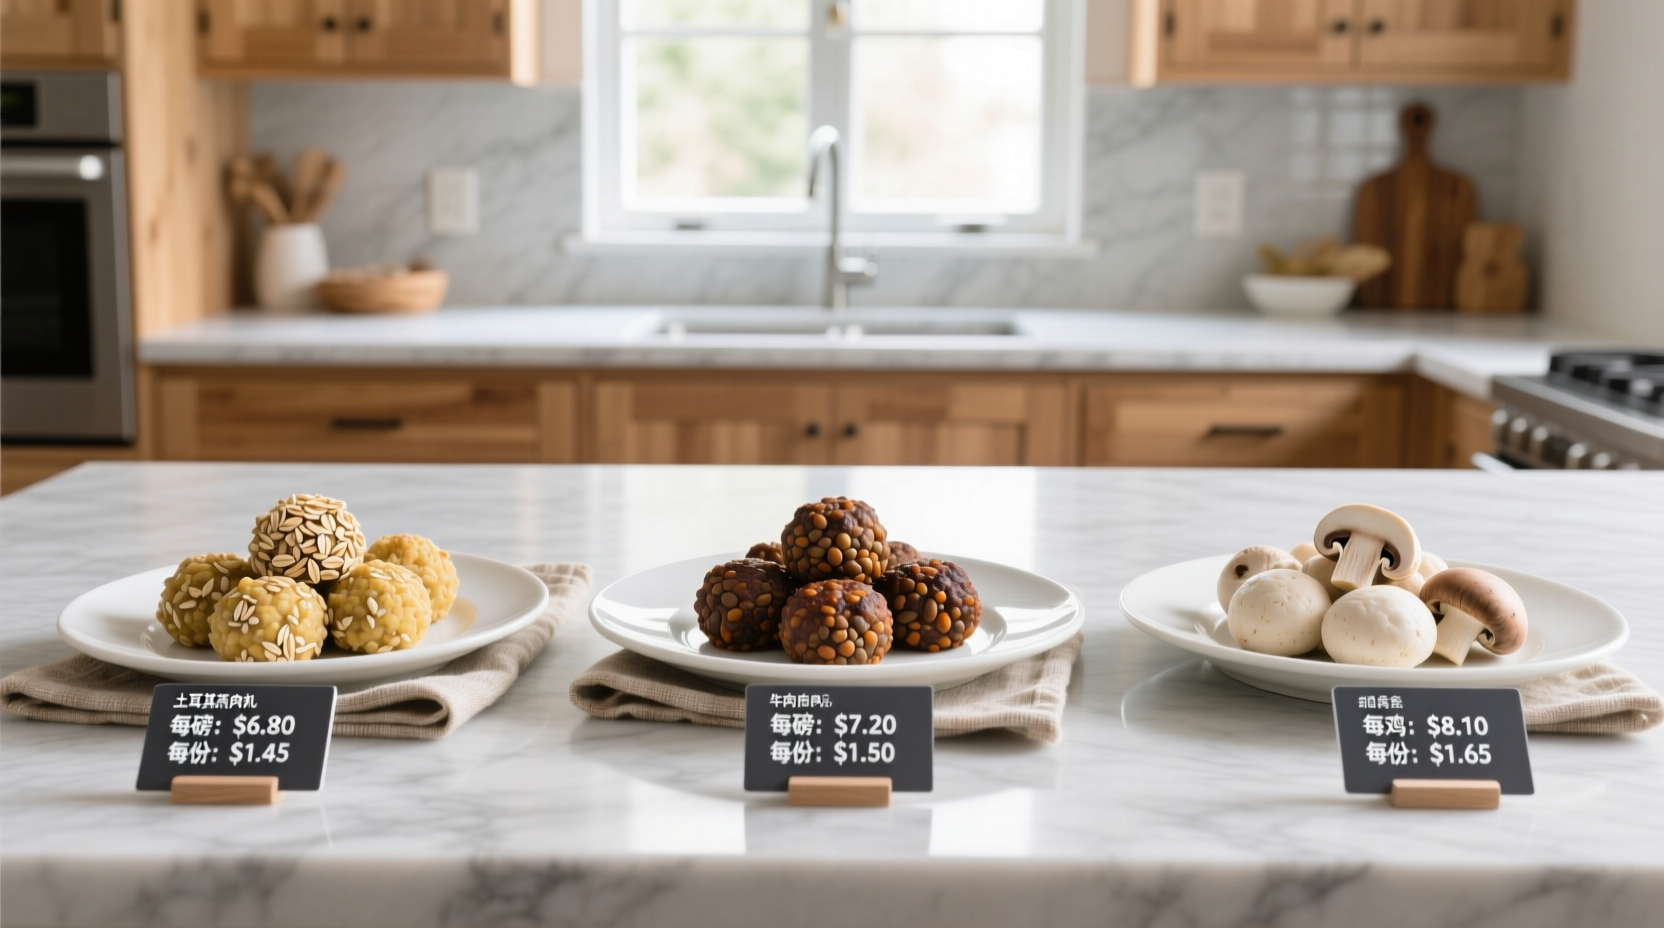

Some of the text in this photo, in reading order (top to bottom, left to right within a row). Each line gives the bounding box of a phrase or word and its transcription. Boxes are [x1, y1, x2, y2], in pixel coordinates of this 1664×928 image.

[232, 714, 296, 739] $6.80
[834, 712, 897, 738] $7.20
[1427, 714, 1489, 739] $8.10
[229, 741, 290, 766] $1.45
[834, 741, 895, 766] $1.50
[1430, 742, 1492, 767] $1.65
